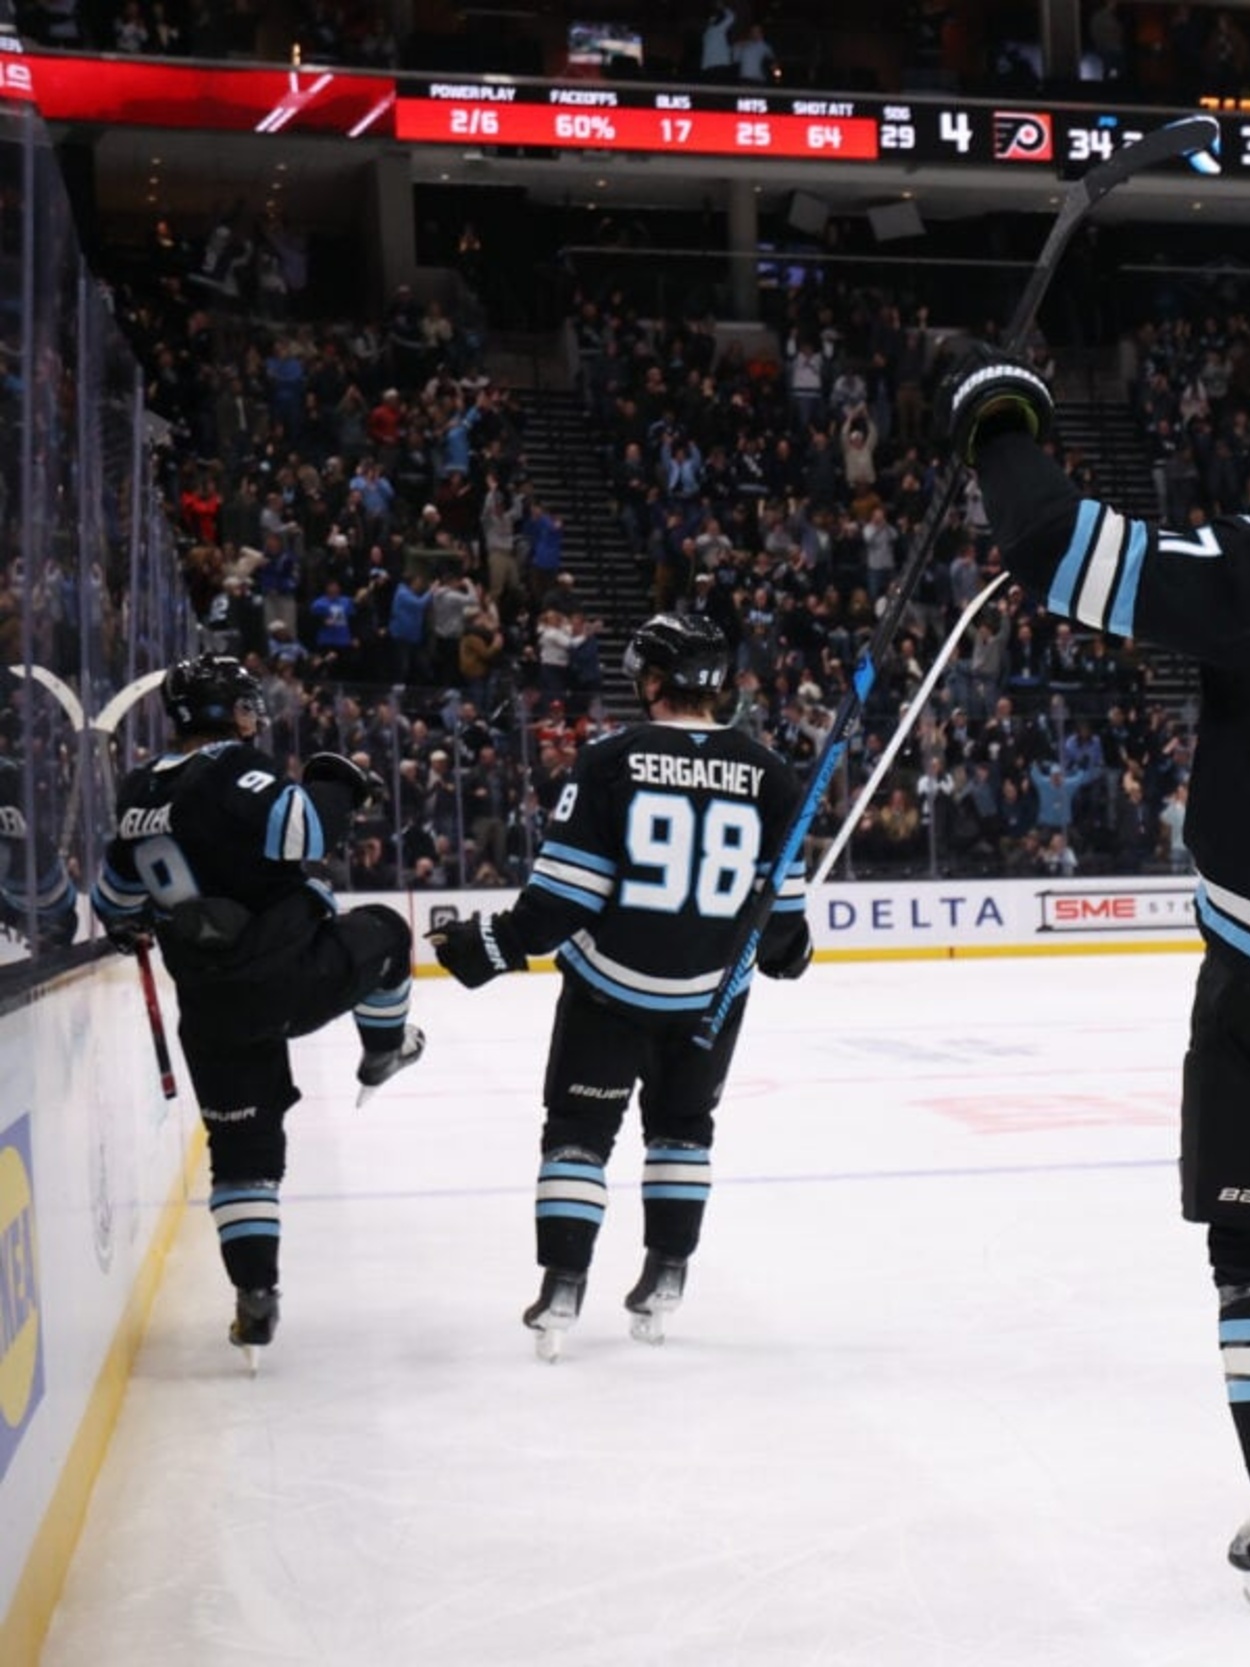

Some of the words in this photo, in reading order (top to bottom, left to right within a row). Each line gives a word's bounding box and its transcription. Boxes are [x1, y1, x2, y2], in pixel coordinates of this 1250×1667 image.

[429, 84, 479, 100] POWER
[481, 87, 516, 101] PLAY
[550, 90, 618, 106] FACEOFFS
[737, 99, 768, 113] HITS
[793, 101, 828, 115] SHOT
[829, 102, 854, 117] ATT
[450, 109, 499, 134] 2/6
[555, 114, 616, 140] 60%
[660, 119, 692, 142] 17
[940, 112, 973, 153] 4
[736, 122, 771, 146] 25
[807, 125, 842, 149] 64
[880, 125, 915, 149] 29
[1157, 526, 1223, 558] 7
[237, 769, 276, 793] 9
[554, 782, 579, 823] 8
[619, 789, 762, 918] 98
[827, 896, 1005, 931] DELTA
[1055, 898, 1137, 921] SME
